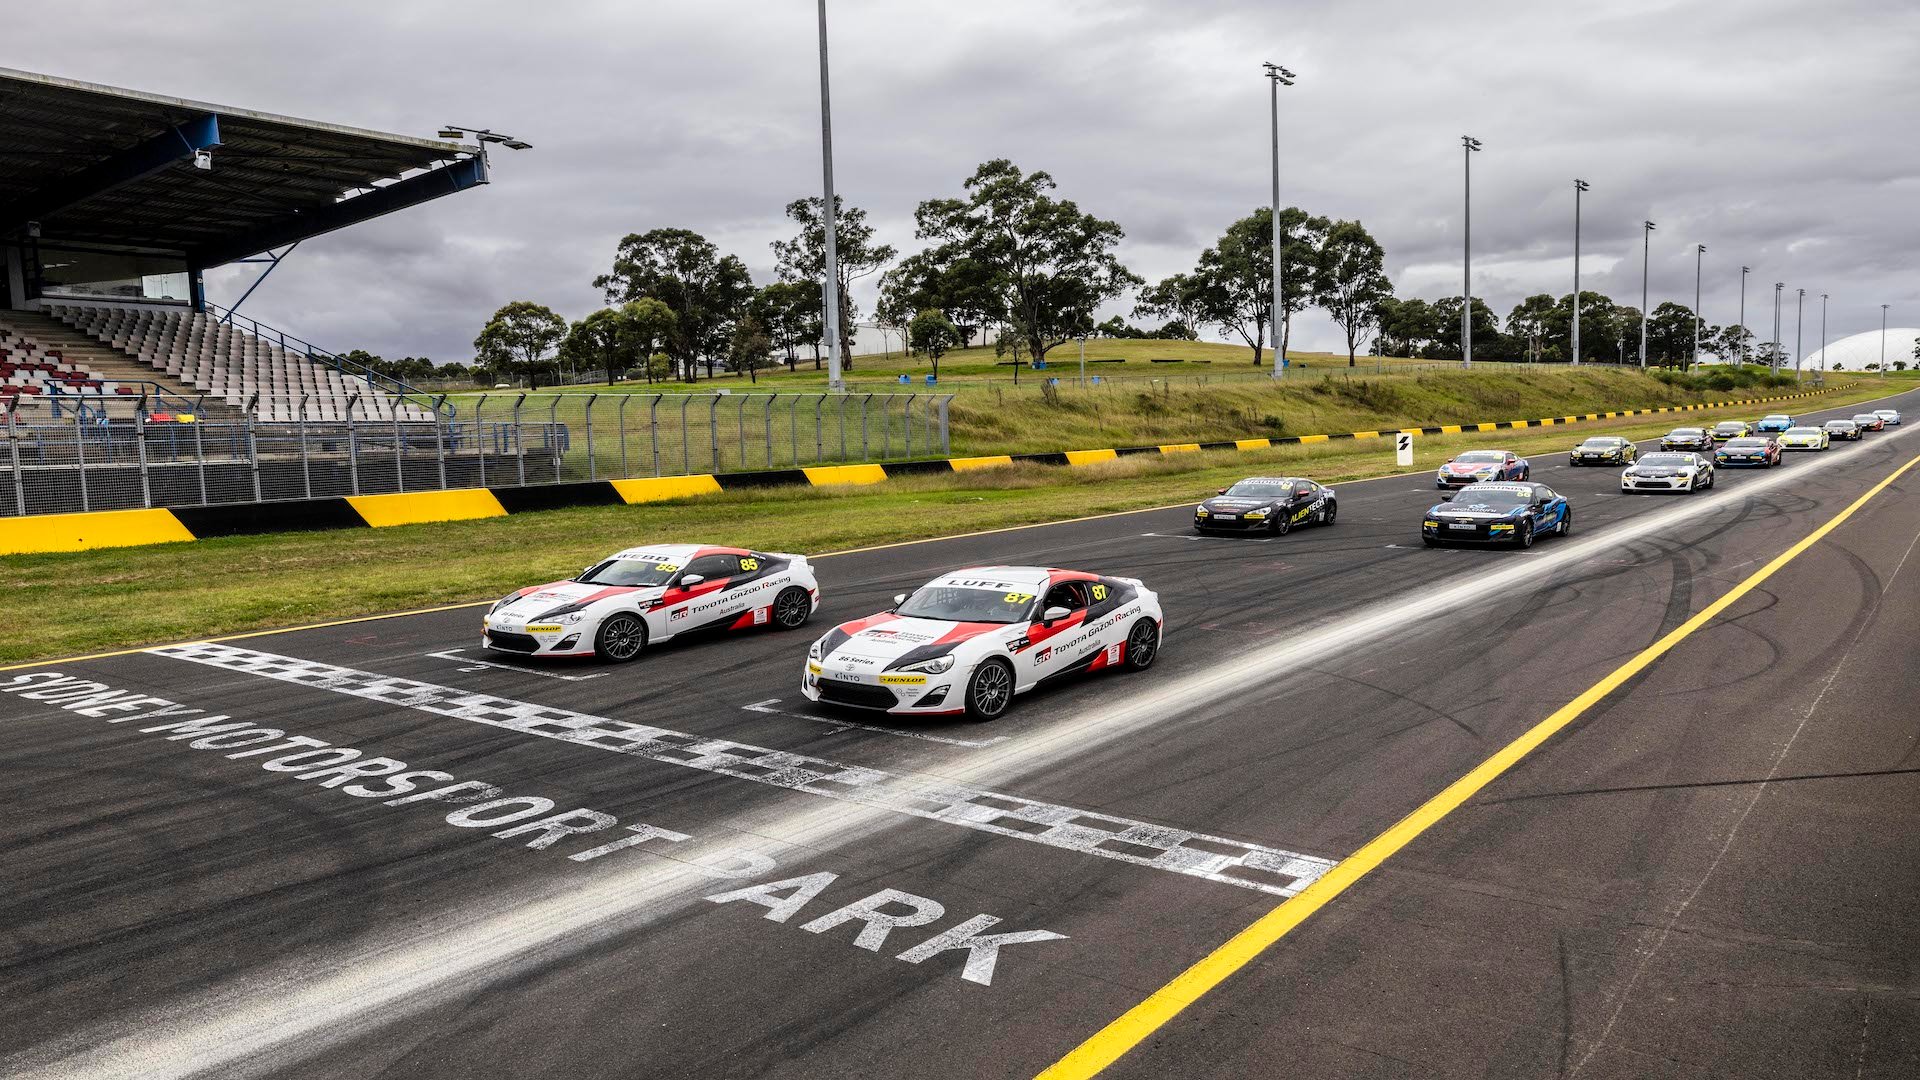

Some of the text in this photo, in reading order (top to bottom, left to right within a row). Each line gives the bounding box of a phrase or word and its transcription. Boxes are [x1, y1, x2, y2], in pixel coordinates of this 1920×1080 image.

[617, 553, 670, 562] WEBB
[655, 563, 677, 573] 85
[740, 558, 758, 571] 85
[947, 580, 1014, 589] LUFF
[691, 576, 791, 614] TOYOTA GAZOO Racing
[1004, 592, 1034, 605] 87
[1092, 584, 1107, 601] 87
[671, 609, 688, 621] GR
[719, 602, 745, 616] Australia
[1054, 634, 1087, 655] TOYOTA
[1088, 620, 1115, 638] GAZOO
[1115, 605, 1141, 622] Racing
[1078, 639, 1101, 656] Australia
[851, 656, 875, 665] Series
[1034, 650, 1052, 667] GR
[0, 672, 1071, 986] SYDNEY MOTORSPORT PARK
